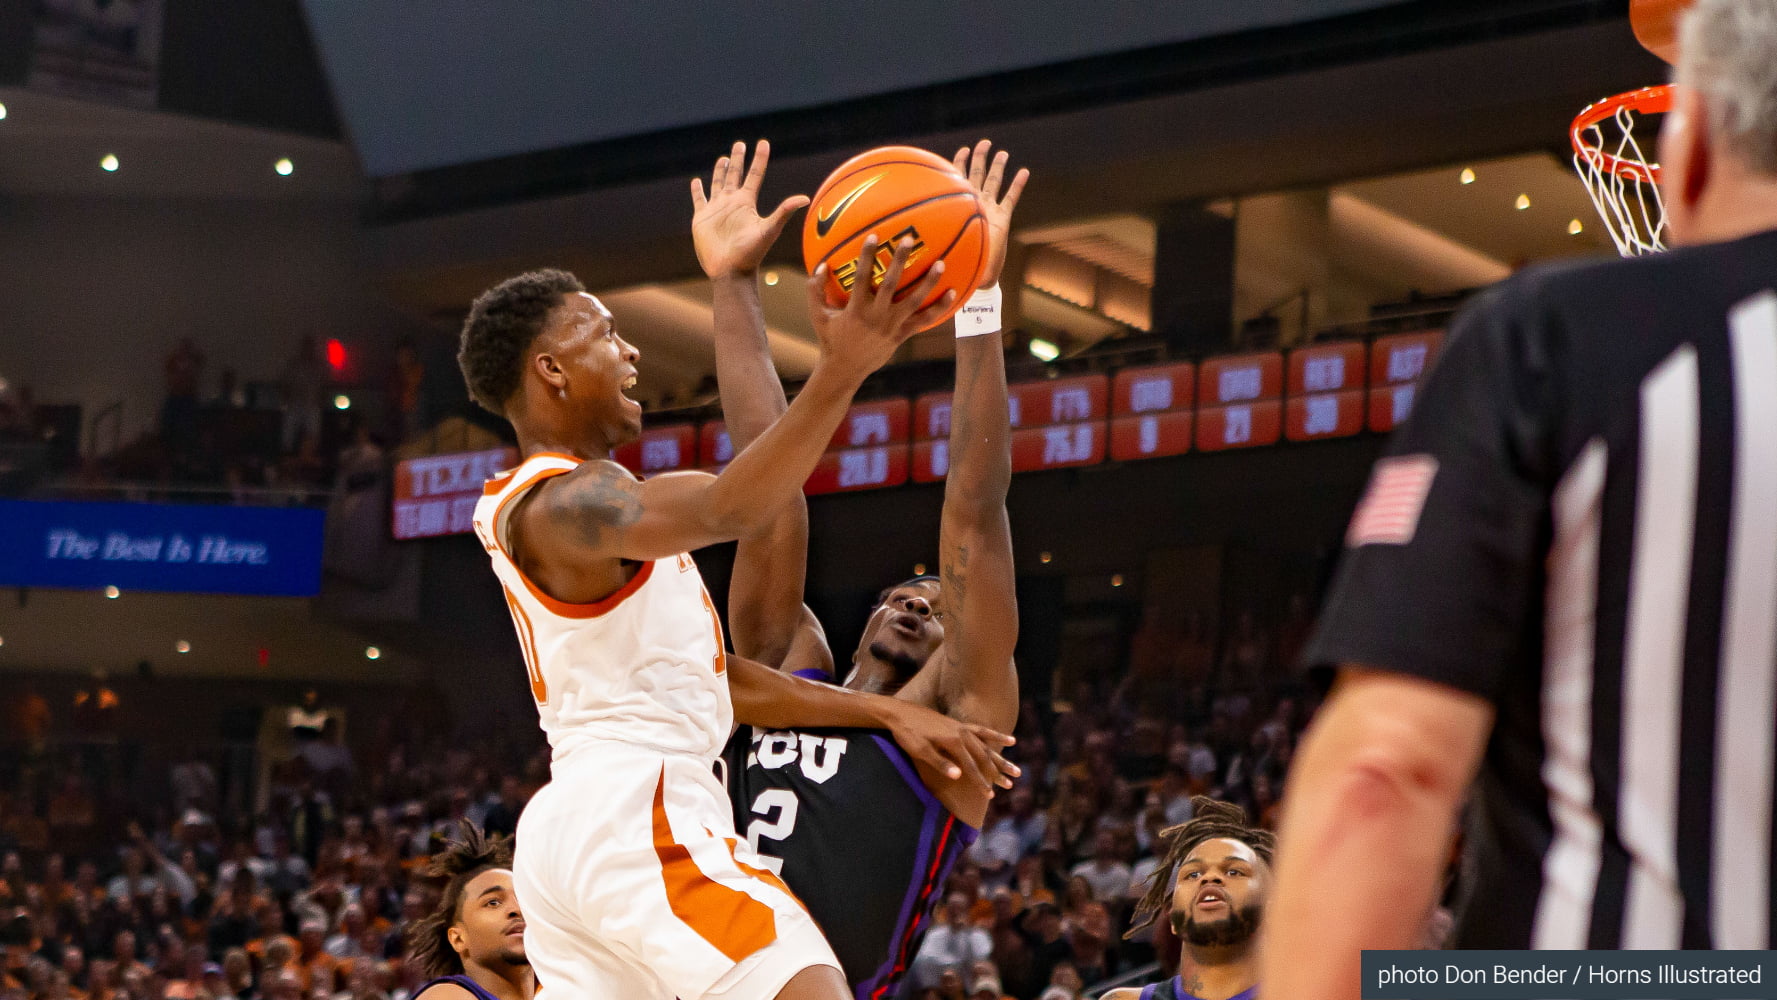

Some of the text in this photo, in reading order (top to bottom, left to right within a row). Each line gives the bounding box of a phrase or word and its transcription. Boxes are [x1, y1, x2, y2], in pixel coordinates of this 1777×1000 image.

[48, 529, 101, 560] The
[103, 531, 164, 562] Best
[166, 535, 193, 563] Is
[746, 788, 799, 876] 2
